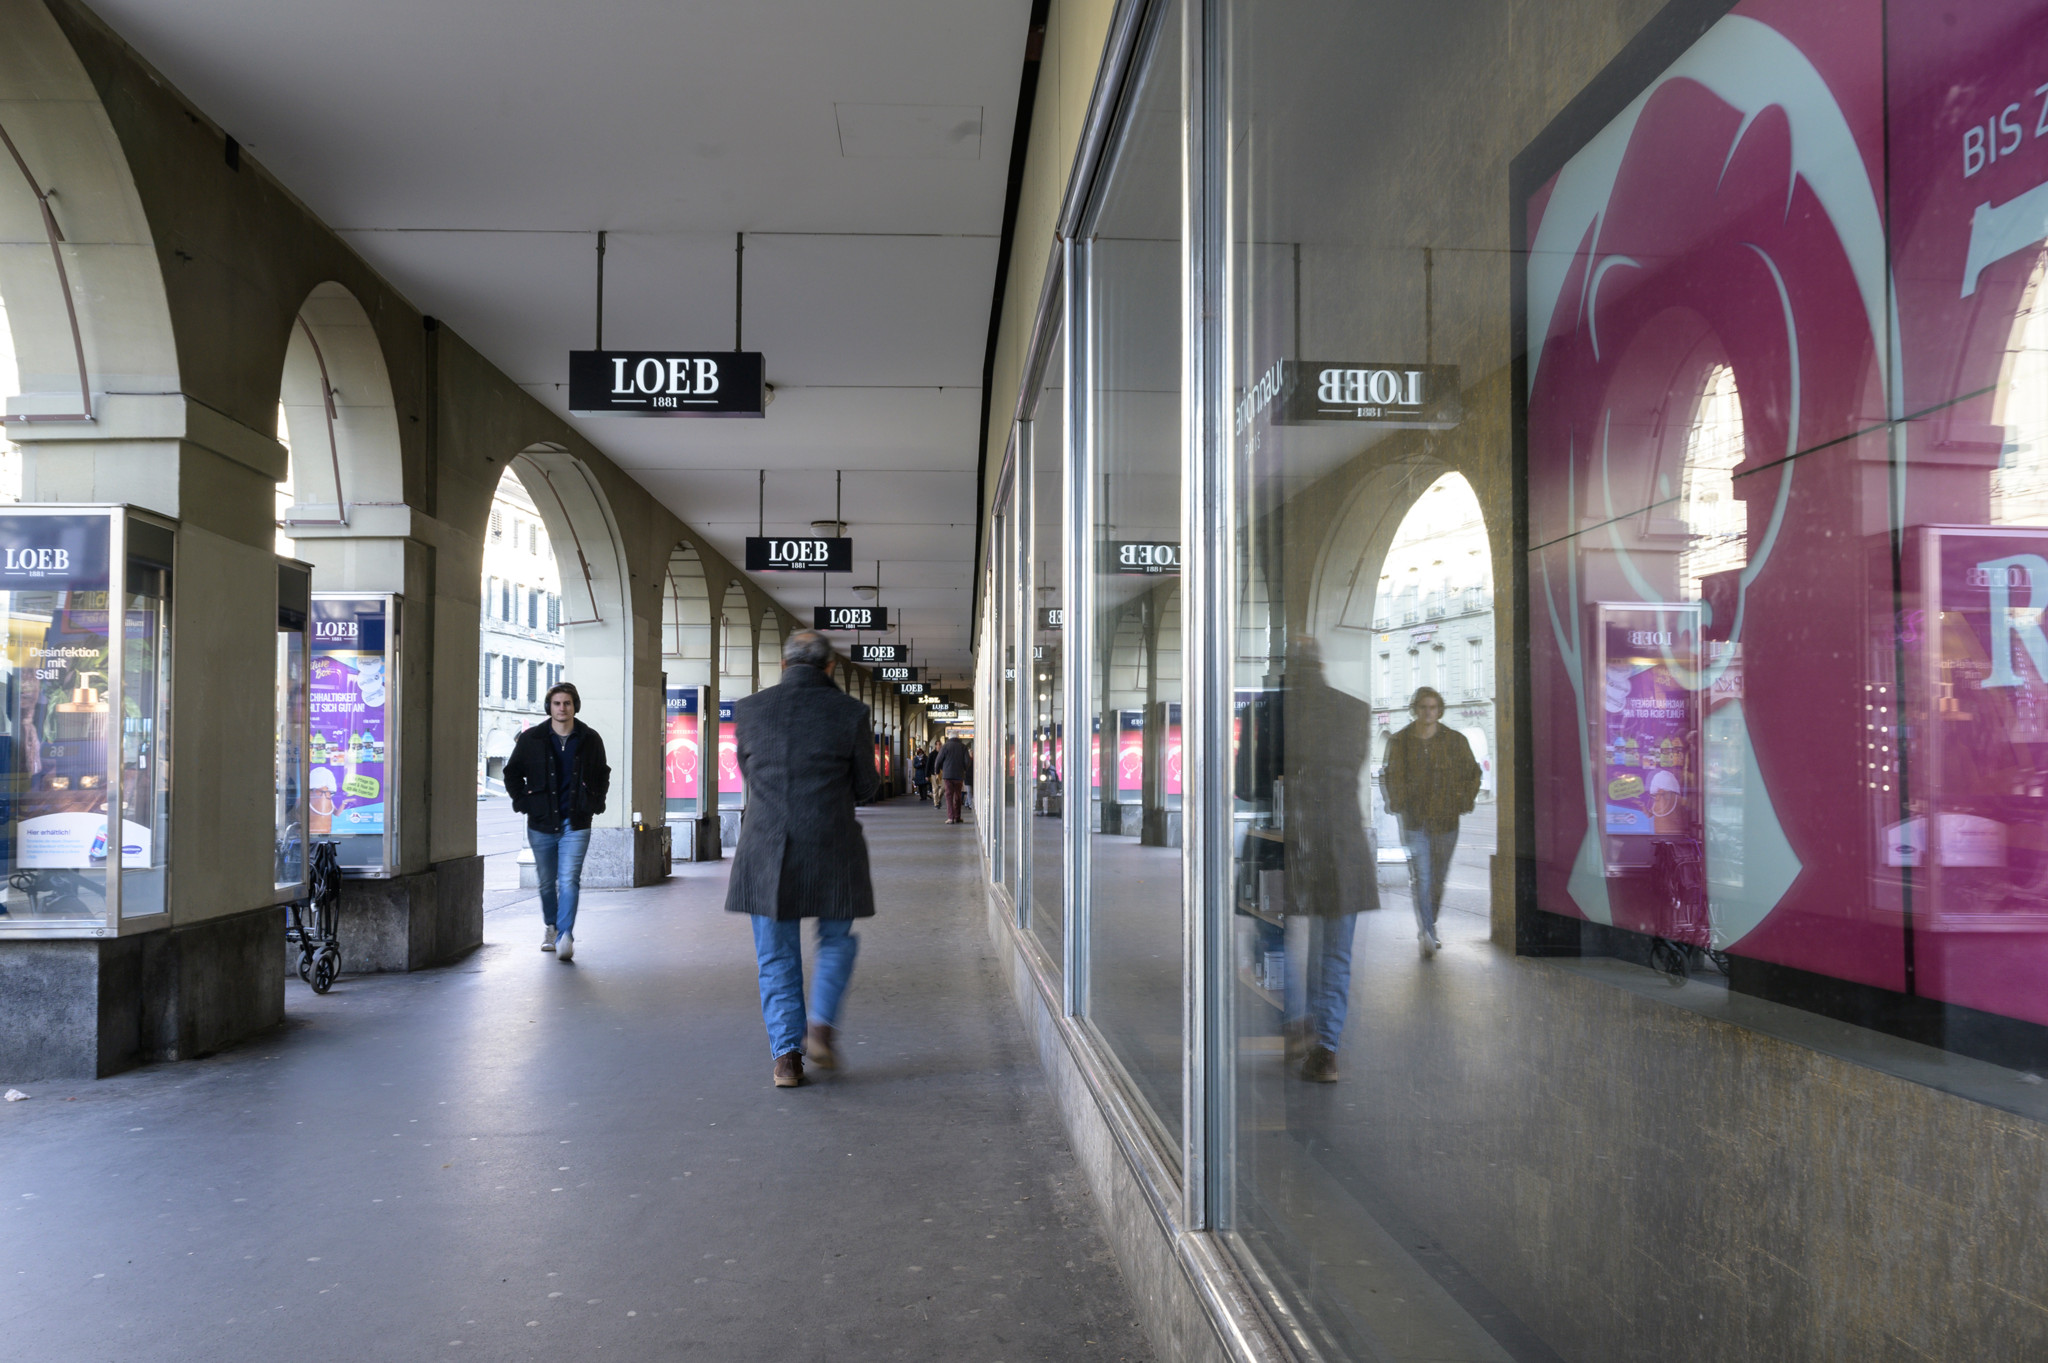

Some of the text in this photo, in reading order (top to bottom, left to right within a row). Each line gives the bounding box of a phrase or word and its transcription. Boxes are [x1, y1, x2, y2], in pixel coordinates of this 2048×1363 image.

[1963, 102, 2022, 179] BIS
[611, 357, 719, 394] LOEB
[652, 396, 678, 408] 1881
[768, 540, 829, 562] LOEB
[5, 548, 70, 570] LOEB
[830, 608, 872, 624] LOEB
[315, 621, 359, 637] LOEB
[29, 647, 100, 658] Desinfektion
[862, 646, 895, 658] LOEB
[47, 658, 67, 668] mit
[35, 669, 59, 680] Stil!
[882, 667, 909, 678] LOEB
[901, 683, 923, 693] LOEB
[321, 703, 338, 713] SICH
[338, 703, 352, 713] GUT
[352, 703, 365, 713] AN!
[667, 698, 687, 707] LOEB
